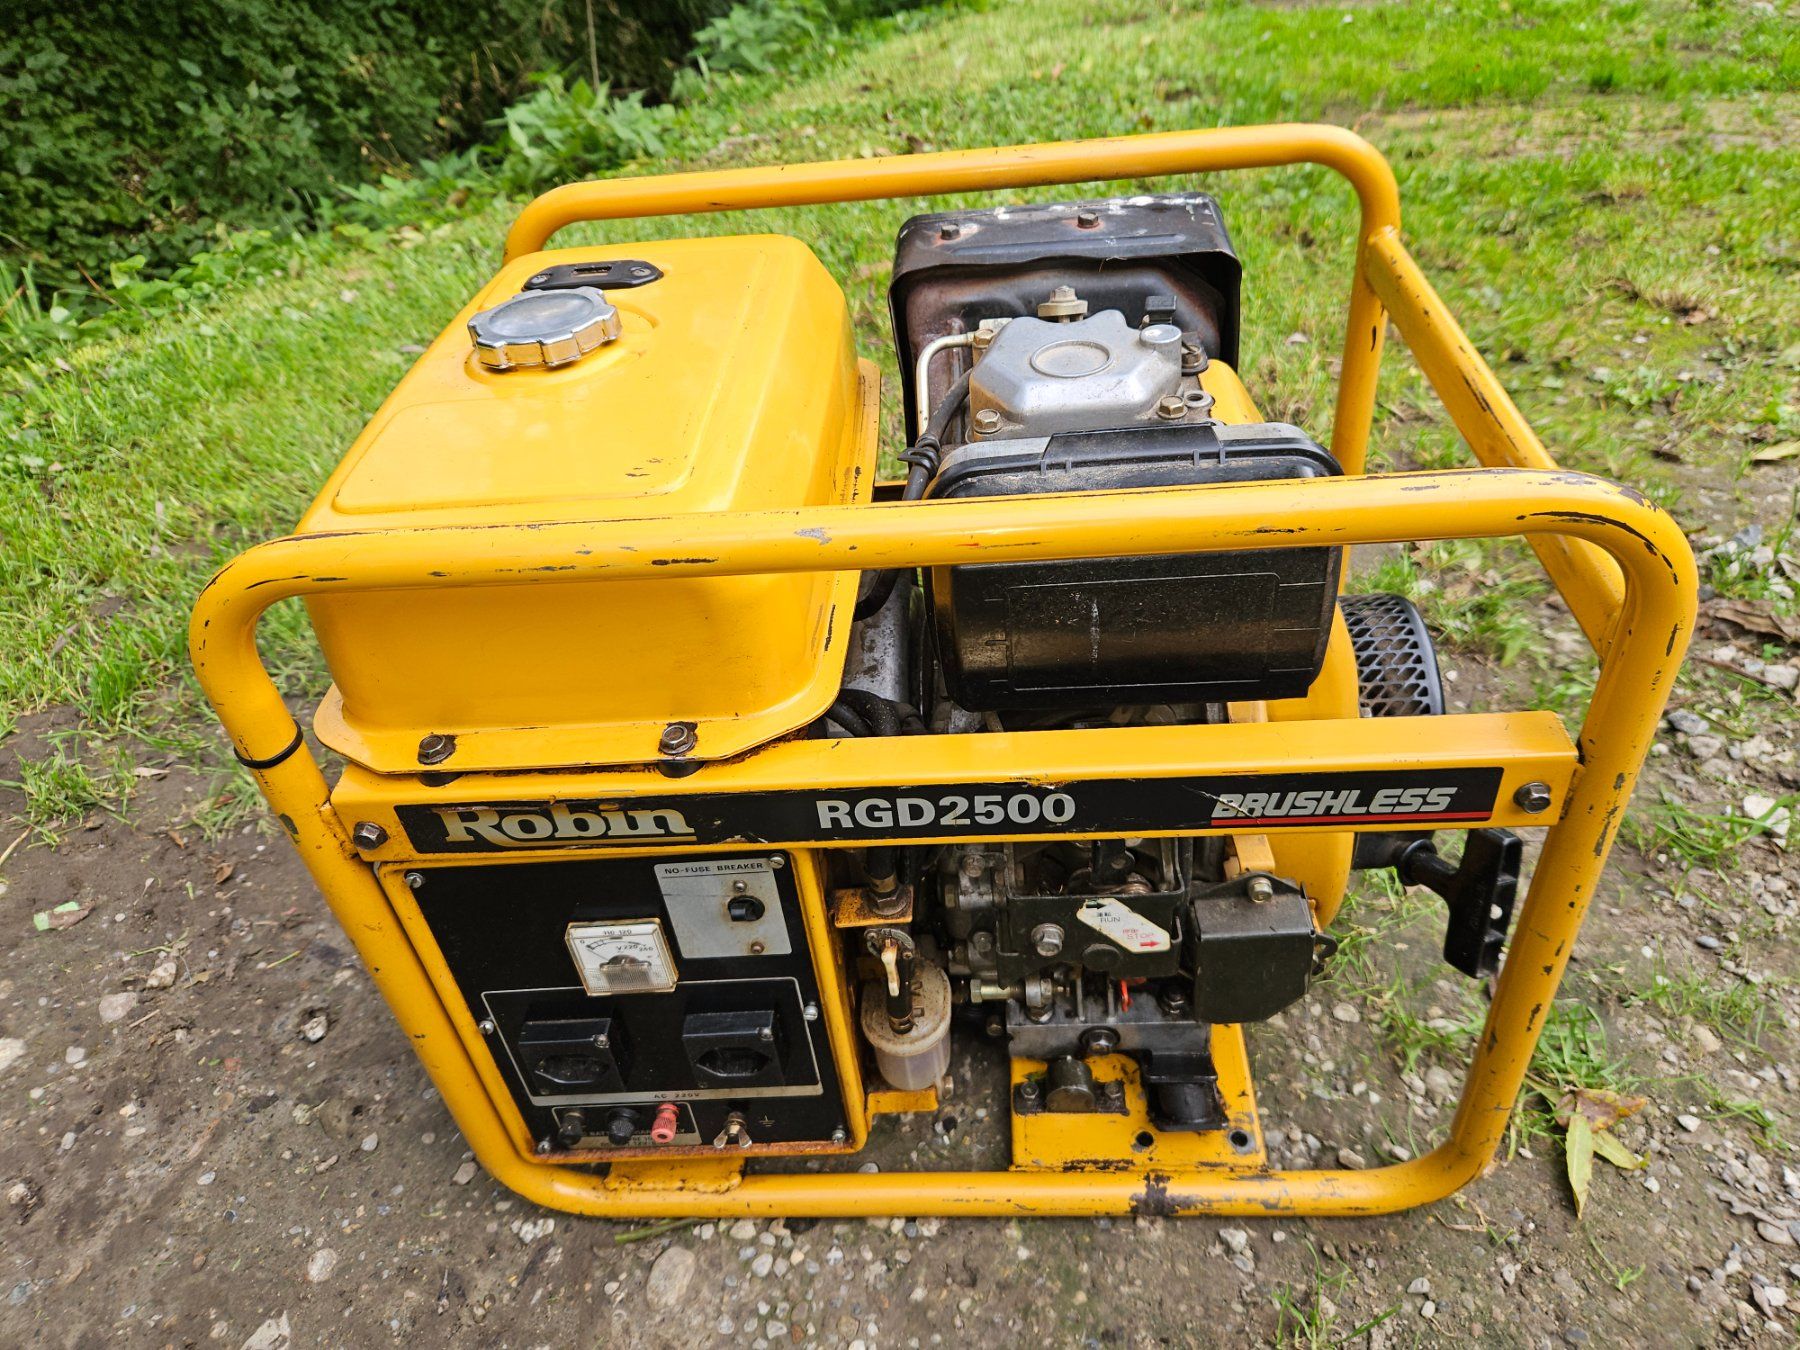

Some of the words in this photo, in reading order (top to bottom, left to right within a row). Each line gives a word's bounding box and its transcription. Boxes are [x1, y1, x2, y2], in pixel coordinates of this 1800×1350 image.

[816, 793, 1076, 829] RGD2500
[1211, 787, 1457, 818] BRUSHLESS
[431, 803, 697, 847] Robin
[664, 866, 711, 874] NO-FUSE
[717, 862, 764, 871] BREAKER
